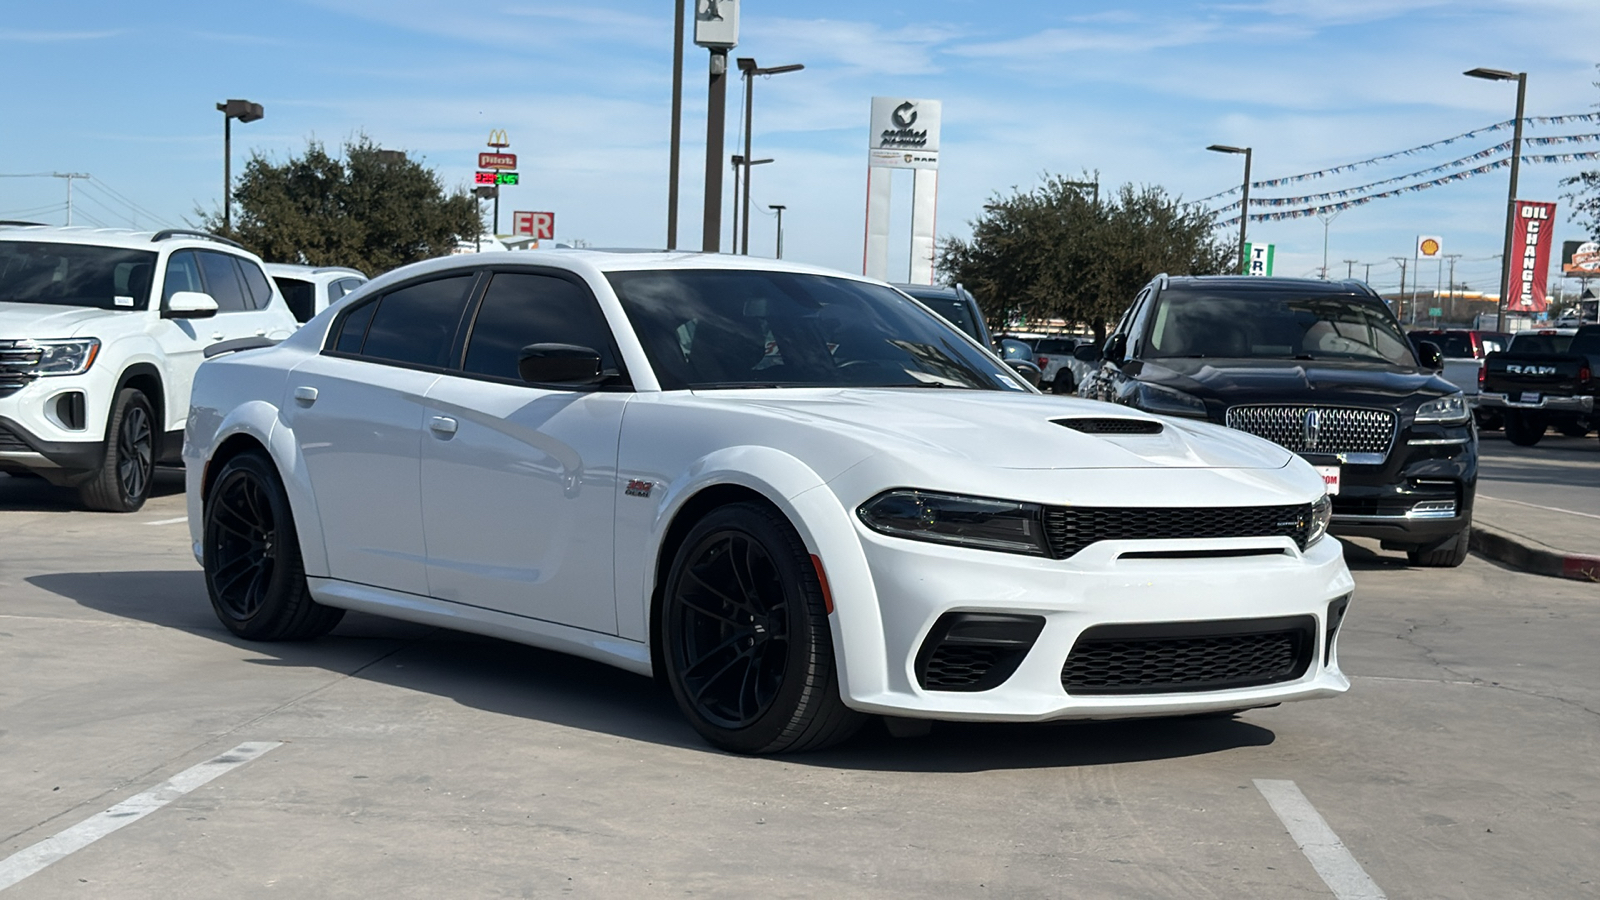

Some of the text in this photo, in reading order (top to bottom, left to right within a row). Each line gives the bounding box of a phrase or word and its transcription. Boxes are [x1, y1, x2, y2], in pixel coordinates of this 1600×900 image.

[481, 155, 513, 166] Pilot
[1521, 206, 1548, 219] OIL
[514, 212, 551, 238] ER
[1520, 221, 1539, 305] CHANGES
[1506, 365, 1556, 374] RAM
